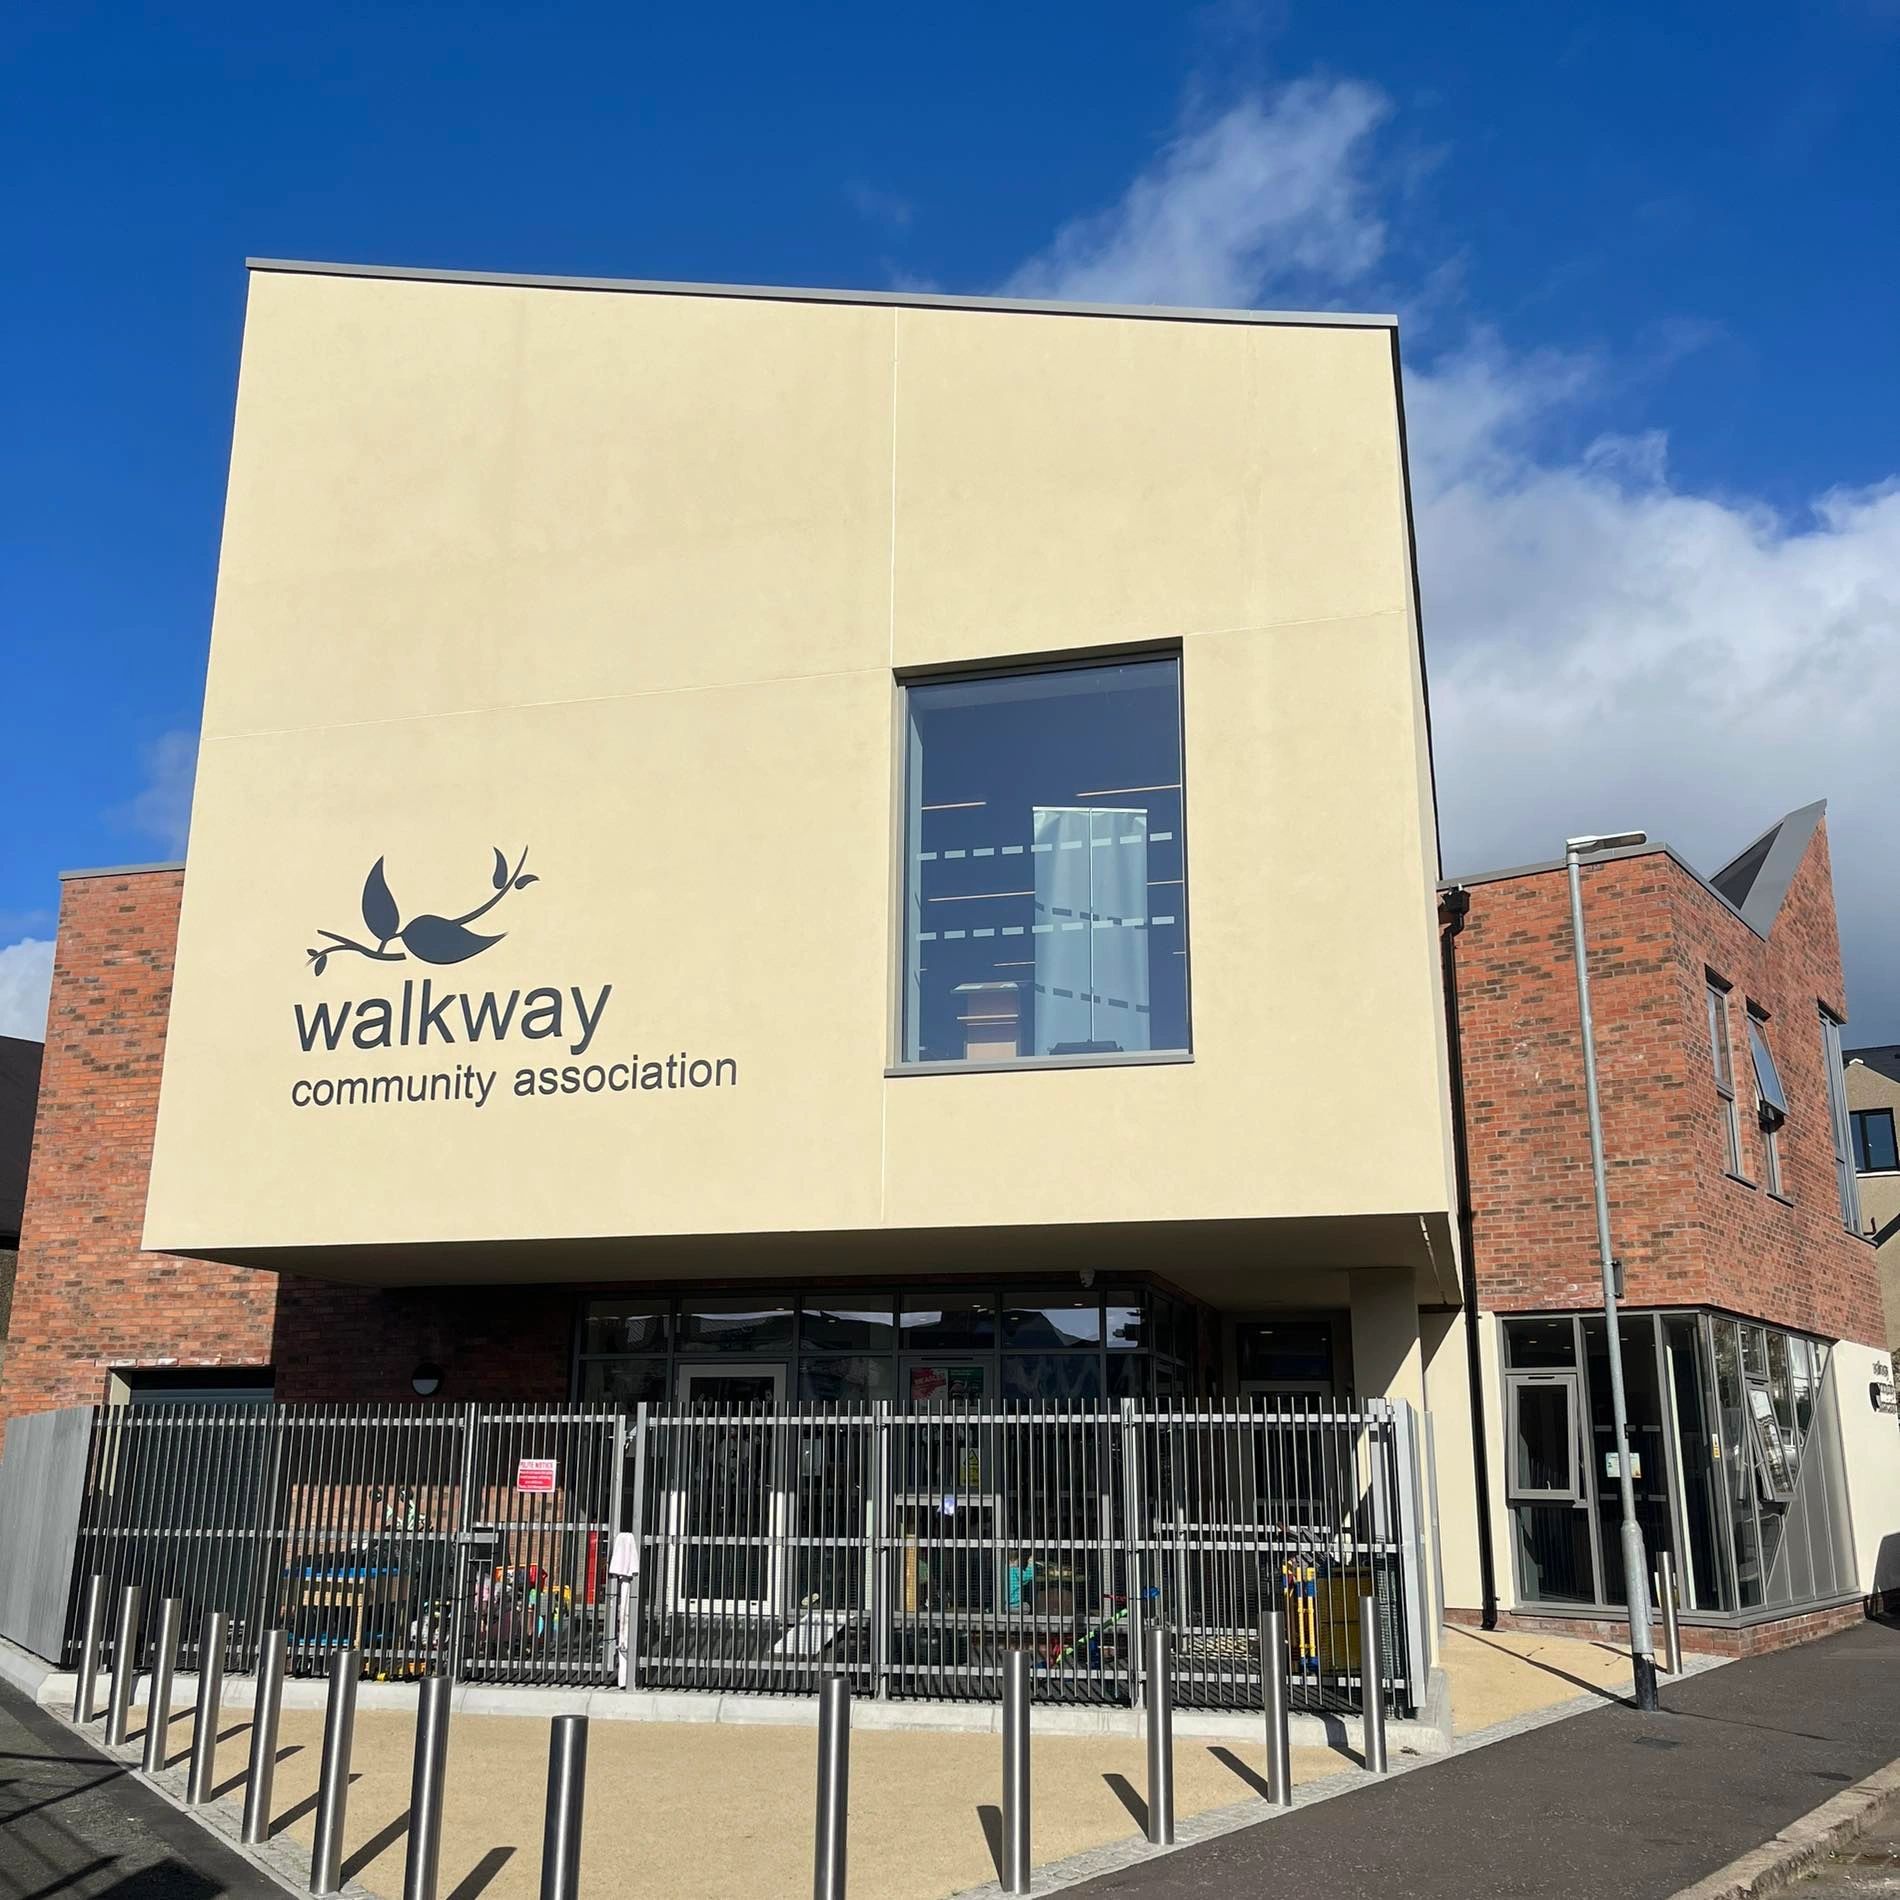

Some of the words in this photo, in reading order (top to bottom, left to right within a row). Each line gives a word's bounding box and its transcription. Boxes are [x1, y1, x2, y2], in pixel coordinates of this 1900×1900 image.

[294, 978, 613, 1056] walkway
[291, 1064, 497, 1108] community
[513, 1052, 737, 1097] association
